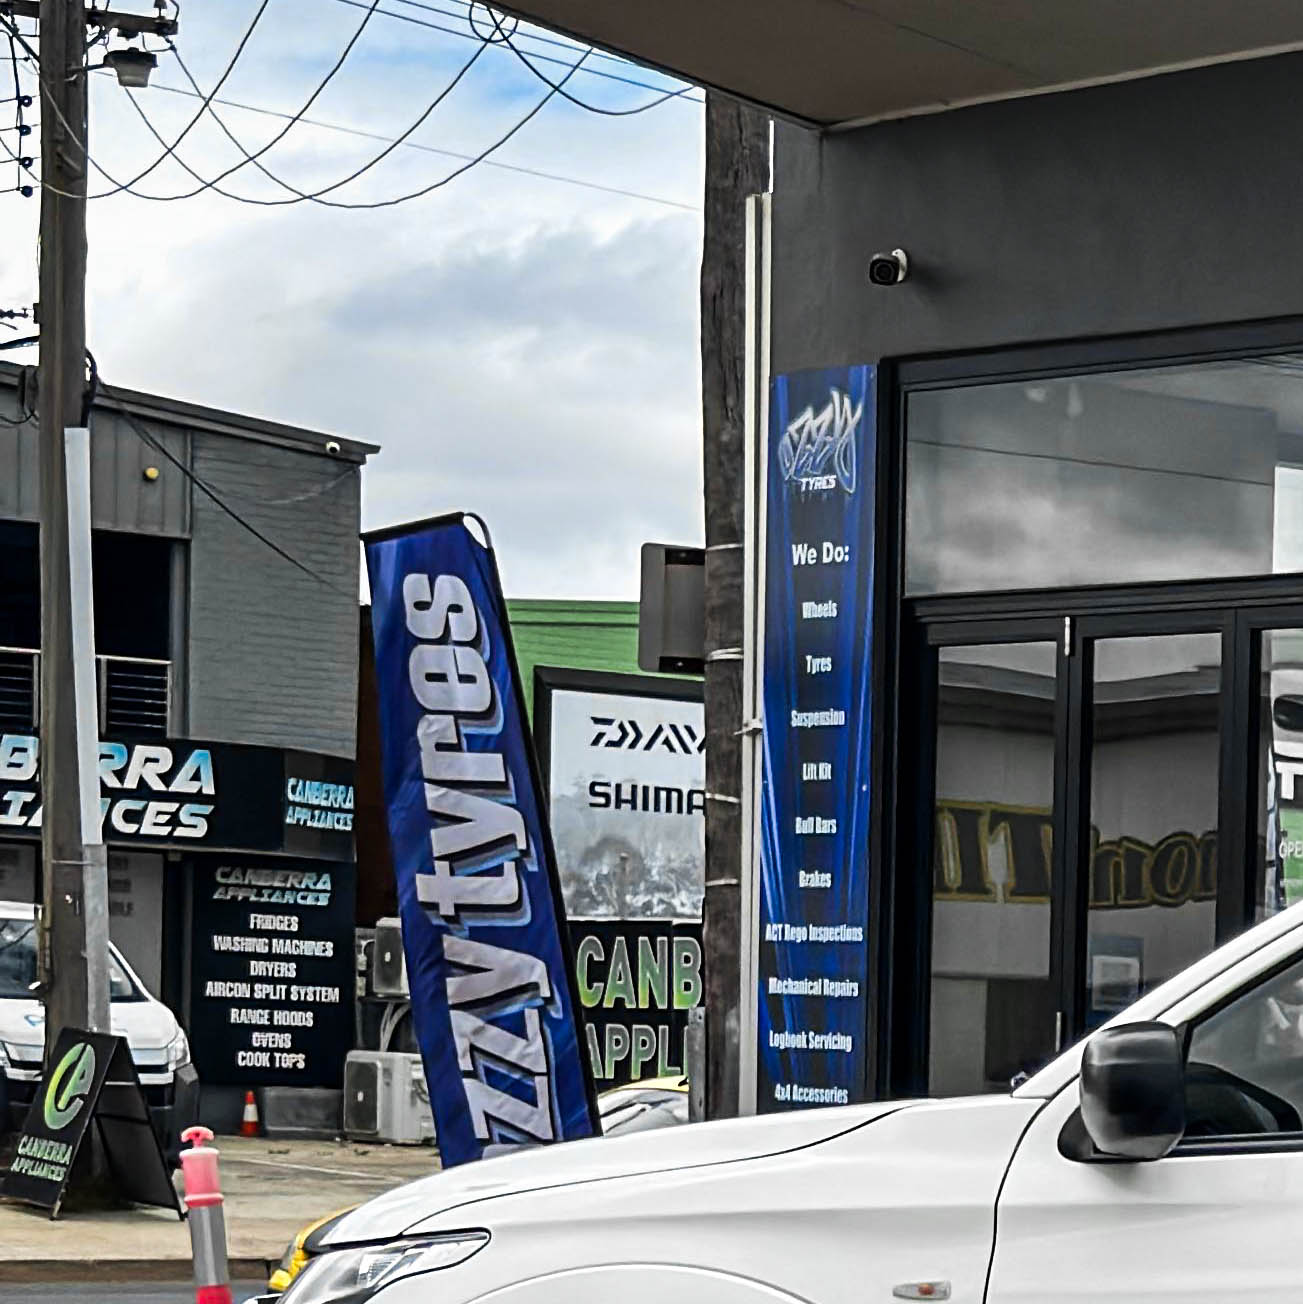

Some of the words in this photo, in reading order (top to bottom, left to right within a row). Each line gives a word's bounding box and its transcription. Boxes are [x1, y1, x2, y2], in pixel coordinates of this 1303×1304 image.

[800, 475, 837, 491] TYRES
[792, 542, 817, 566] We
[822, 541, 850, 564] Do:
[802, 600, 838, 619] Wheels
[806, 655, 832, 674] Tyres
[791, 708, 845, 728] Suspension
[0, 735, 215, 795] BRRA
[803, 763, 817, 781] Lift
[819, 762, 832, 780] Kit
[288, 777, 354, 809] CANBERRA
[0, 791, 215, 838] ICES
[286, 806, 354, 831] APPLIANCES
[795, 817, 813, 834] Bull
[815, 816, 837, 834] Bars
[402, 572, 556, 1160] zzytyres
[216, 866, 331, 890] CANBERRA
[799, 870, 832, 888] Brakes
[213, 886, 331, 906] APPLIANCES
[250, 913, 299, 932] FRIDGES
[765, 924, 783, 941] ACT
[785, 924, 807, 943] Rego
[809, 923, 864, 943] Inspections
[213, 935, 269, 953] WASHING
[272, 938, 334, 957] MACHINES
[250, 960, 297, 978] DRYERS
[577, 935, 702, 1009] CANB
[205, 981, 250, 998] AIRCON
[253, 983, 287, 1000] SPLIT
[290, 985, 340, 1003] SYSTEM
[768, 977, 822, 996] Mechanical
[824, 978, 859, 998] Repairs
[230, 1008, 271, 1025] RANGE
[273, 1010, 314, 1027] HOODS
[252, 1032, 292, 1048] OVENS
[769, 1030, 807, 1049] Logbook
[809, 1031, 853, 1053] Servicing
[237, 1051, 271, 1067] COOK
[274, 1053, 306, 1069] TOPS
[775, 1084, 792, 1101] 4x4
[793, 1084, 849, 1105] Accessories
[17, 1135, 73, 1165] CANBERRA
